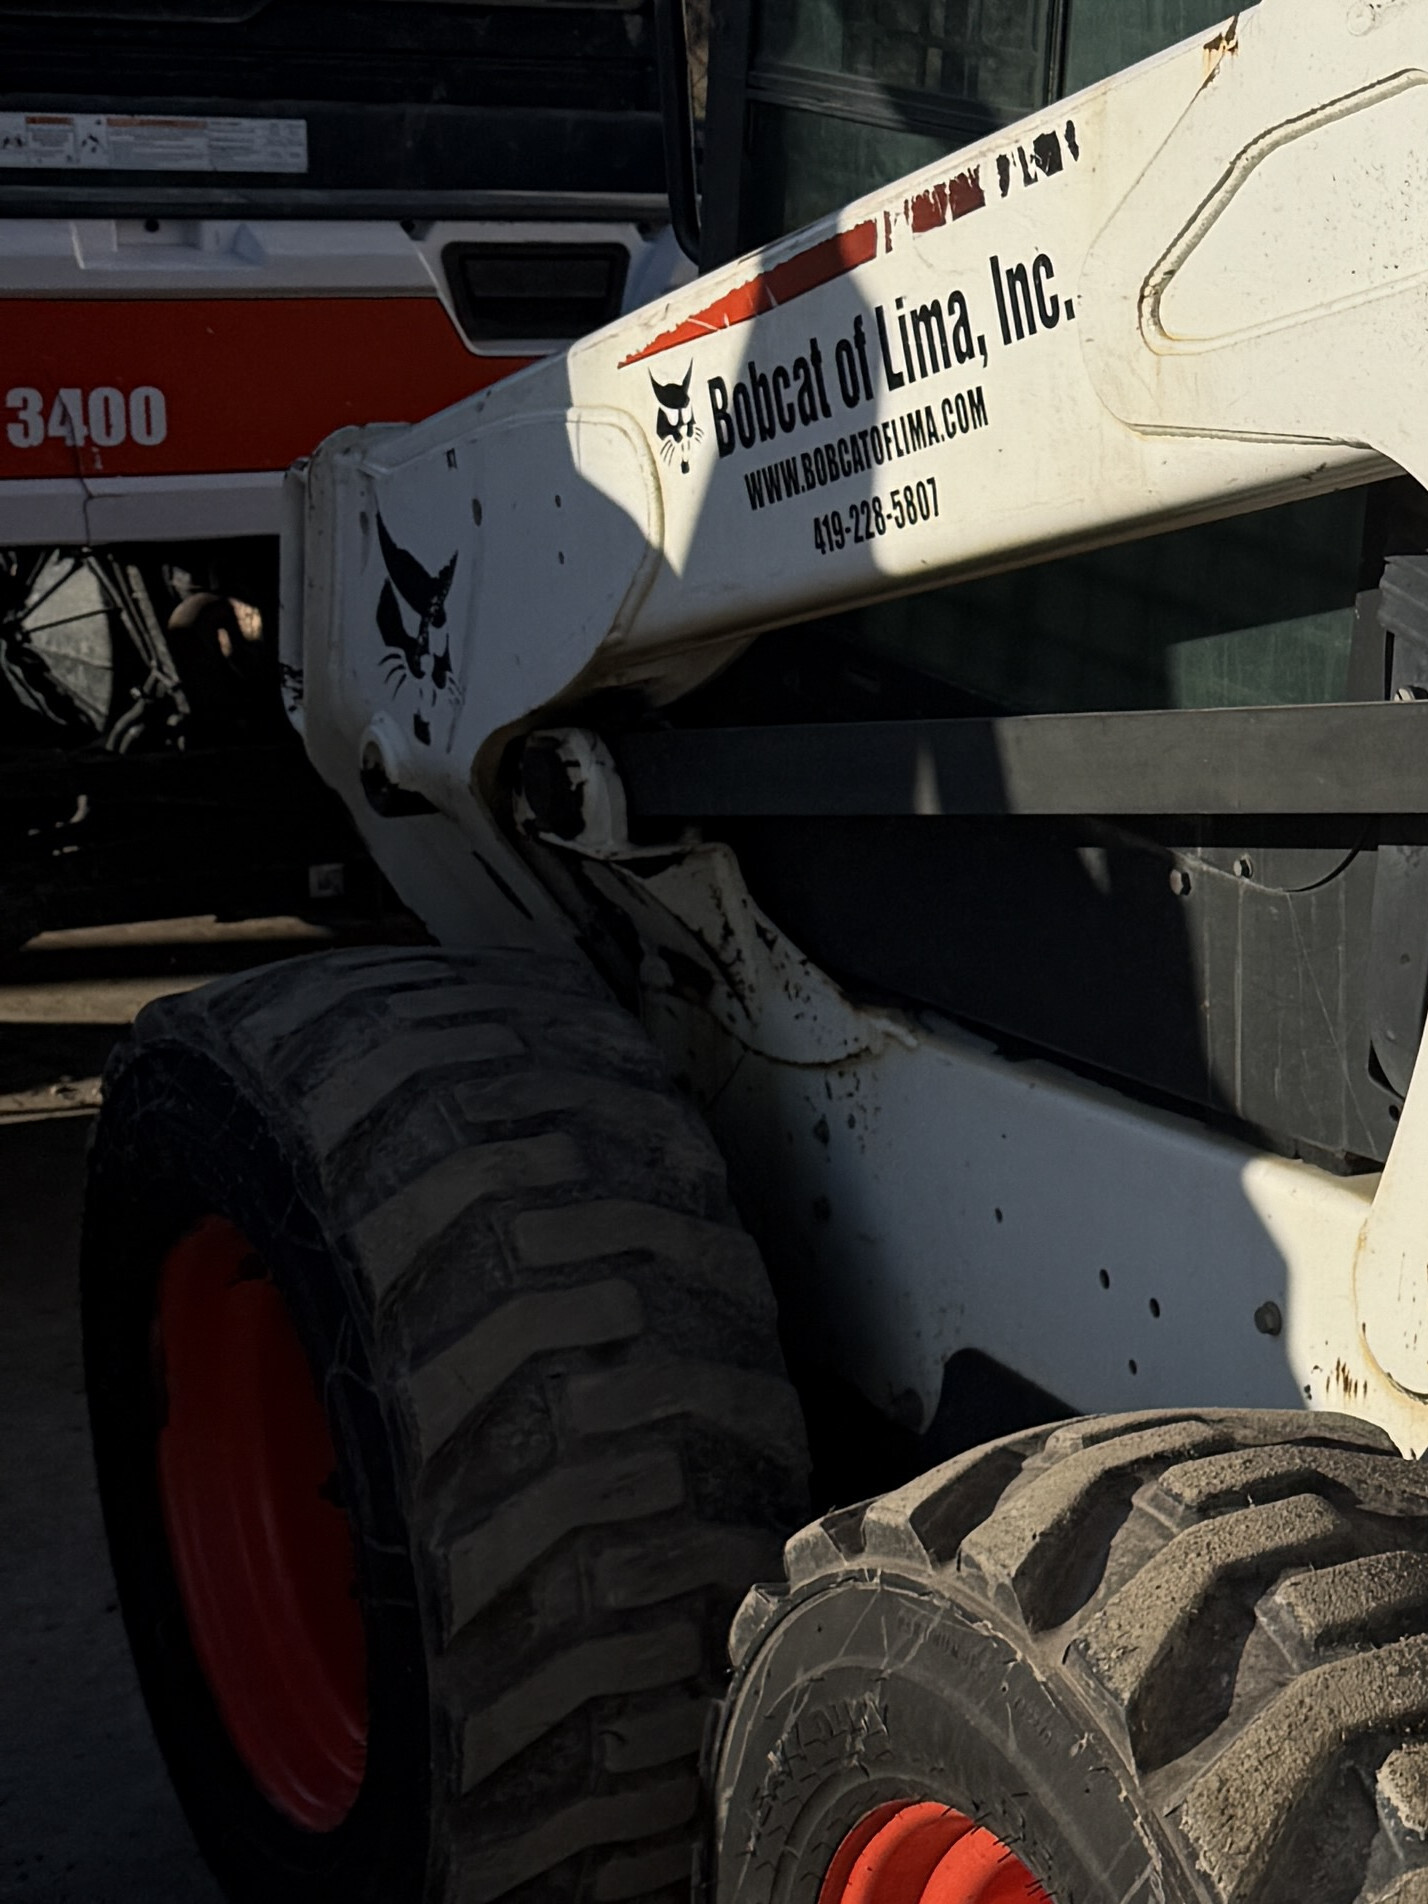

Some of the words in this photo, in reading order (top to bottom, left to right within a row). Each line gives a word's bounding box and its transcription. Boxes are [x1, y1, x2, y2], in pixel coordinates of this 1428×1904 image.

[707, 337, 832, 459] Bobcat
[835, 314, 875, 409] of
[875, 289, 989, 392] Lima,
[990, 253, 1076, 346] Inc.
[5, 385, 168, 449] 3400
[744, 385, 989, 511] WWW.BOBCATOFLIMA.COM
[812, 476, 941, 556] 419-228-5807
